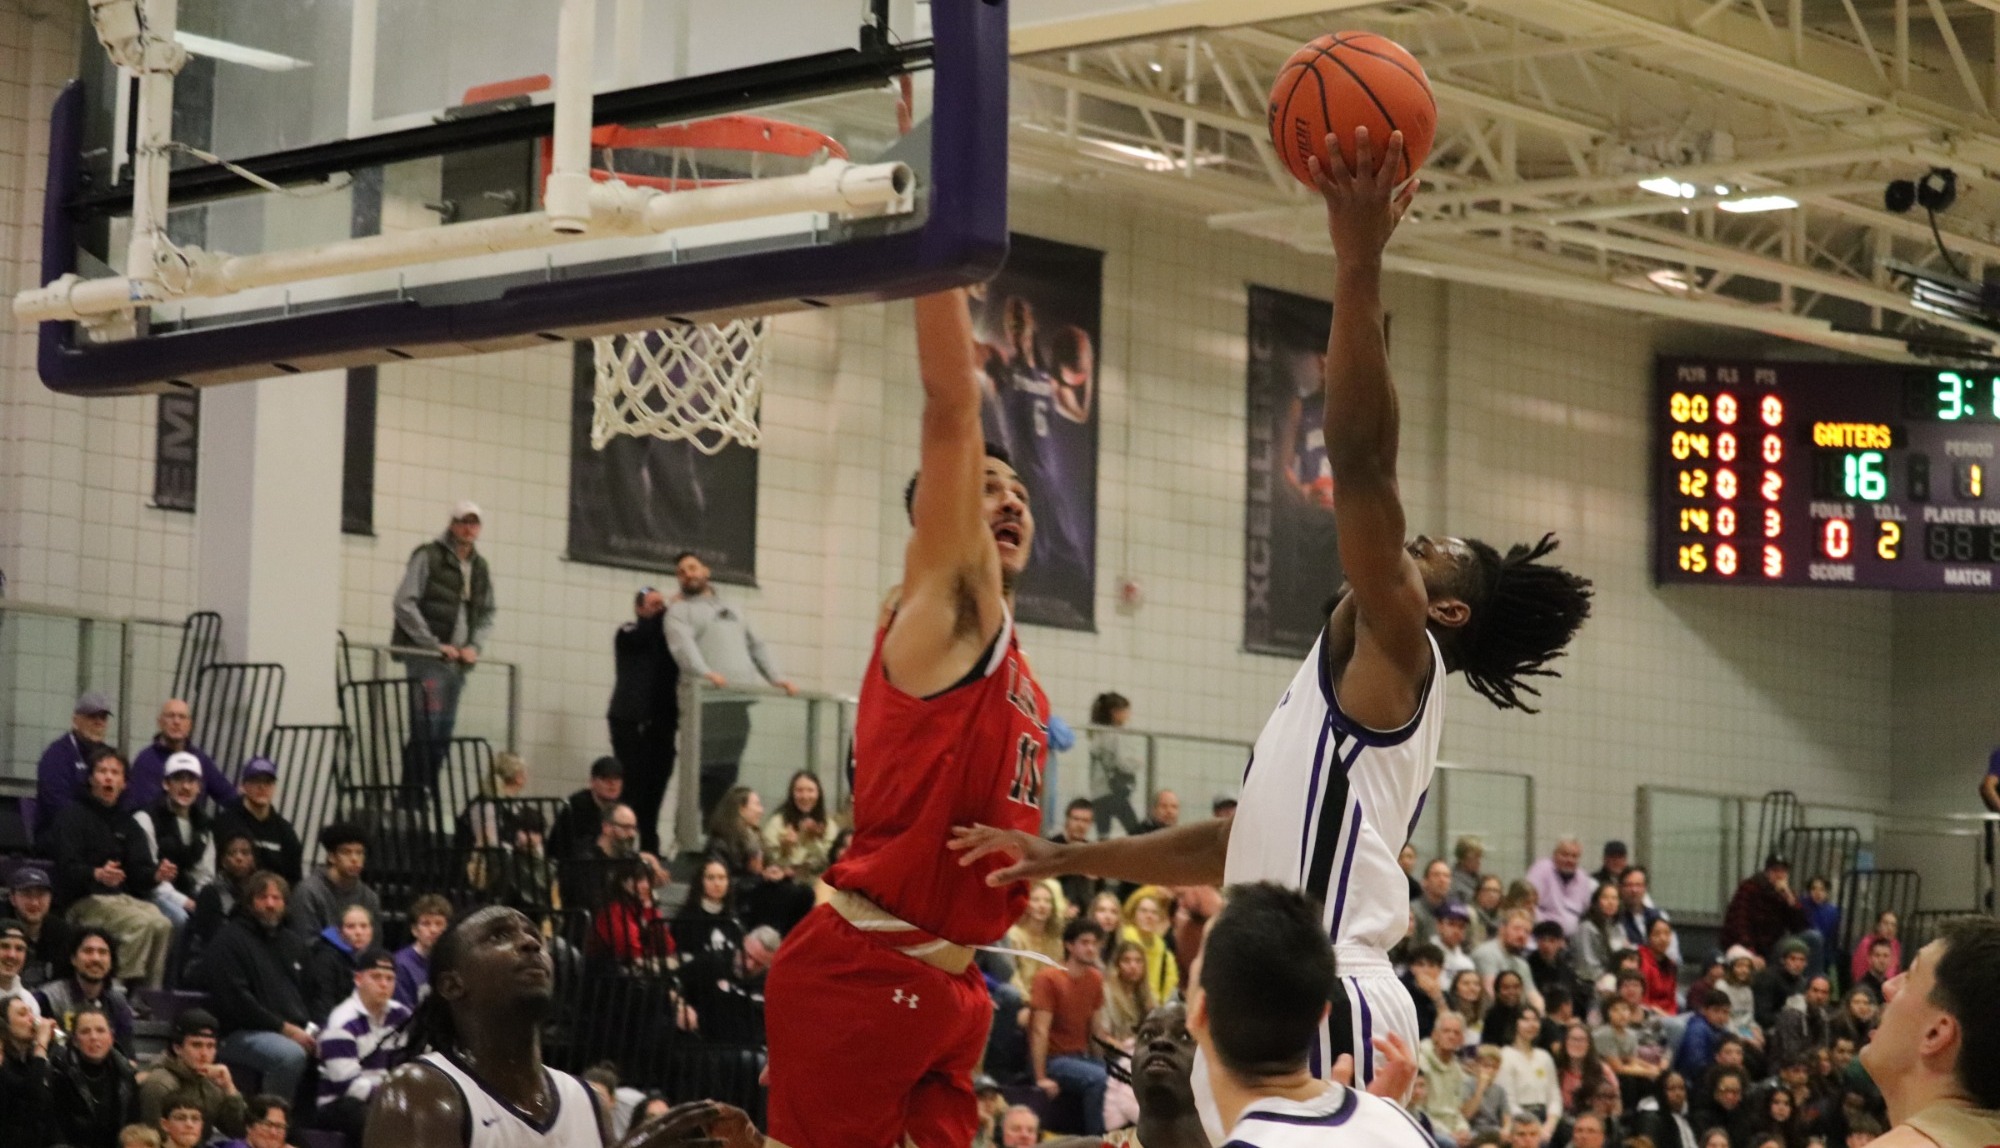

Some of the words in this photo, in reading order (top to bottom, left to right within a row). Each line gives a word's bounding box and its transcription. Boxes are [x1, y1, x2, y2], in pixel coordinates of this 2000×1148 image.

[1670, 392, 1709, 423] 00
[1716, 393, 1737, 425] 0
[1762, 395, 1782, 426] 0
[1671, 430, 1709, 460] 04
[1717, 432, 1736, 461] 0
[1763, 433, 1781, 463] 0
[1679, 468, 1708, 498] 12
[1716, 468, 1737, 500] 0
[1761, 469, 1782, 501] 2
[1844, 452, 1886, 500] 16
[1680, 508, 1709, 533] 14
[1716, 506, 1735, 536] 0
[1764, 508, 1781, 538] 3
[1810, 502, 1855, 519] FOULS
[1923, 506, 1975, 523] PLAYER
[1826, 519, 1849, 558] 0
[1877, 521, 1900, 559] 2
[1679, 543, 1707, 573] 15
[1716, 543, 1737, 575] 0
[1763, 544, 1782, 577] 3
[1809, 564, 1855, 582] SCORE
[1944, 568, 1992, 587] MATCH
[1007, 732, 1040, 809] 11
